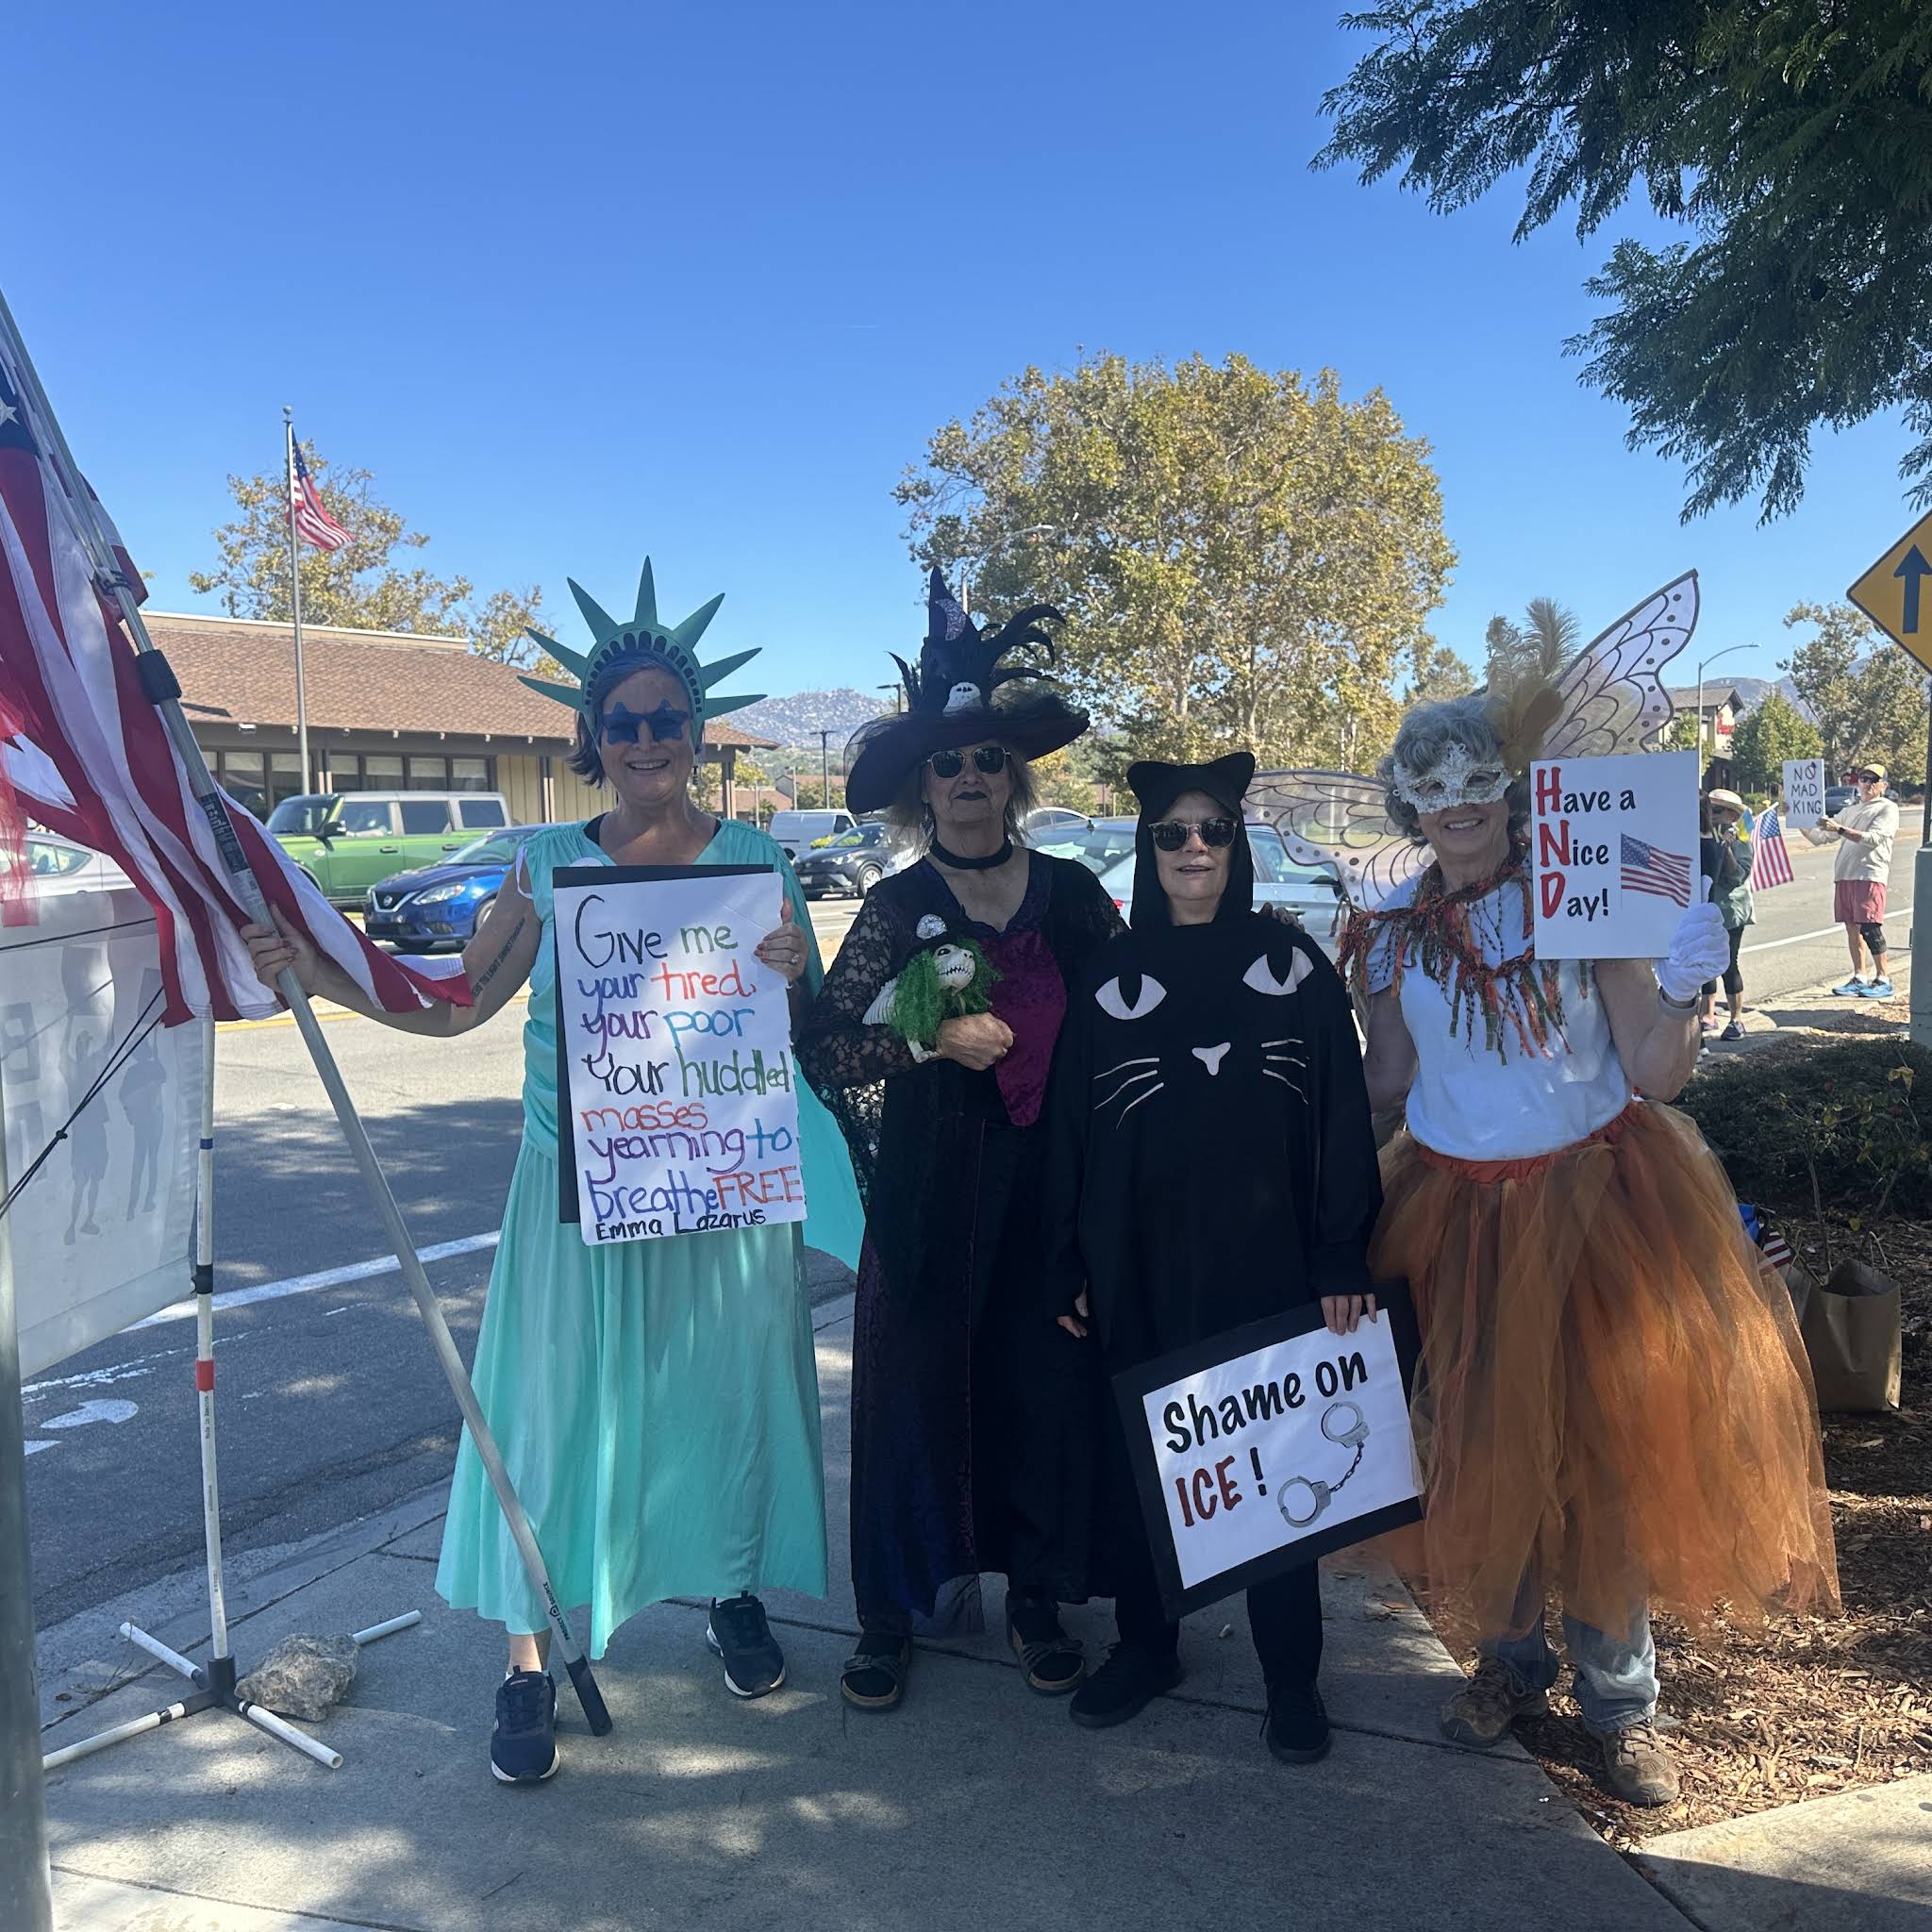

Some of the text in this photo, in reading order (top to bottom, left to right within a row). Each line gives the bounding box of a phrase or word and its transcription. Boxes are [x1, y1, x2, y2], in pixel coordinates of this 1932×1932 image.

[1536, 767, 1636, 816] Have a
[1791, 784, 1817, 797] MAD
[1792, 800, 1822, 814] KING
[1539, 820, 1609, 868] Nice
[1541, 872, 1608, 922] Day!
[575, 894, 668, 969] Give
[680, 924, 739, 954] me
[577, 973, 645, 1026] your
[580, 1008, 755, 1063] your poor
[584, 1045, 790, 1098] Your huddled
[580, 1100, 708, 1132] masses
[588, 1118, 792, 1184] yearning to
[585, 1165, 802, 1222] breathe FREE
[595, 1208, 766, 1241] Emma Lazarus
[1163, 1352, 1368, 1453] Shame on
